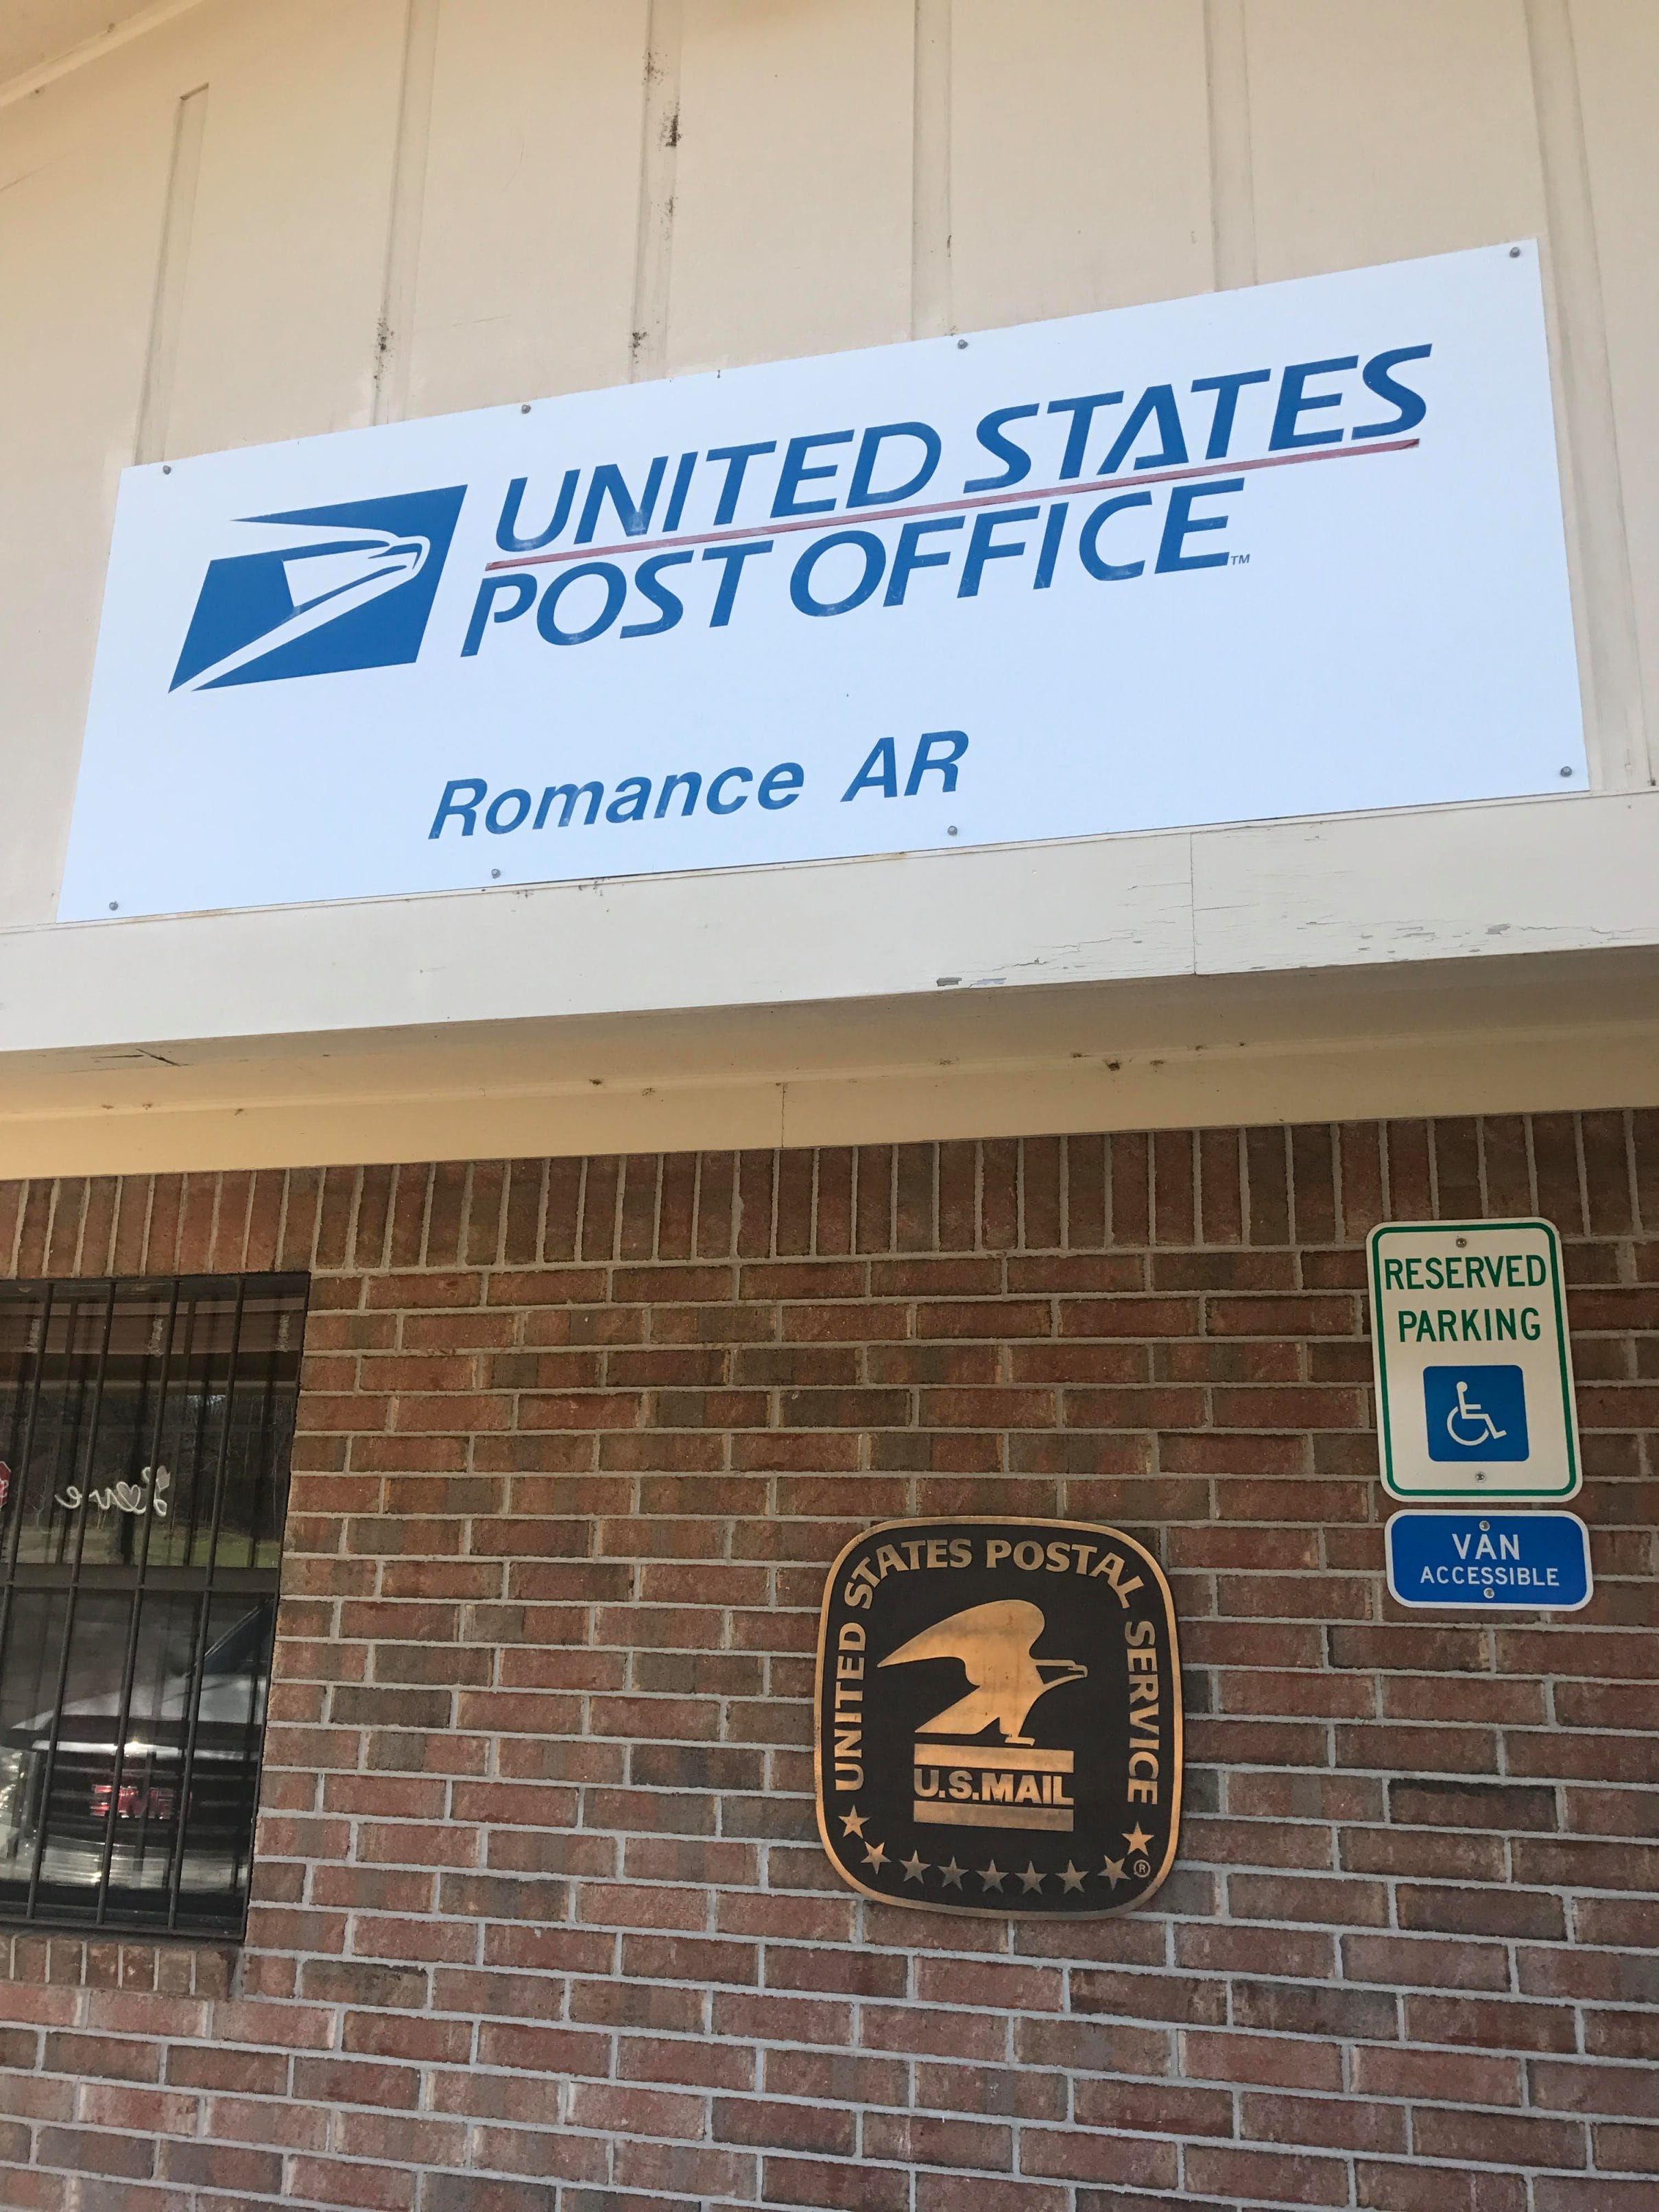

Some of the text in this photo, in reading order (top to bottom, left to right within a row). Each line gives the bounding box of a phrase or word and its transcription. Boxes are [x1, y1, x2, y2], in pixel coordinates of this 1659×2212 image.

[496, 344, 1432, 553] UNITED STATES
[460, 540, 774, 657] POST
[789, 477, 1245, 617] OFFICE
[428, 730, 969, 840] Romance AR
[1384, 1254, 1547, 1290] RESERVED
[1398, 1307, 1542, 1342] PARKING
[1420, 1566, 1560, 1586] ACCESSIBLE
[1451, 1533, 1520, 1560] VAN
[834, 1538, 1160, 1805] UNITED STATES POSTAL SERVICE
